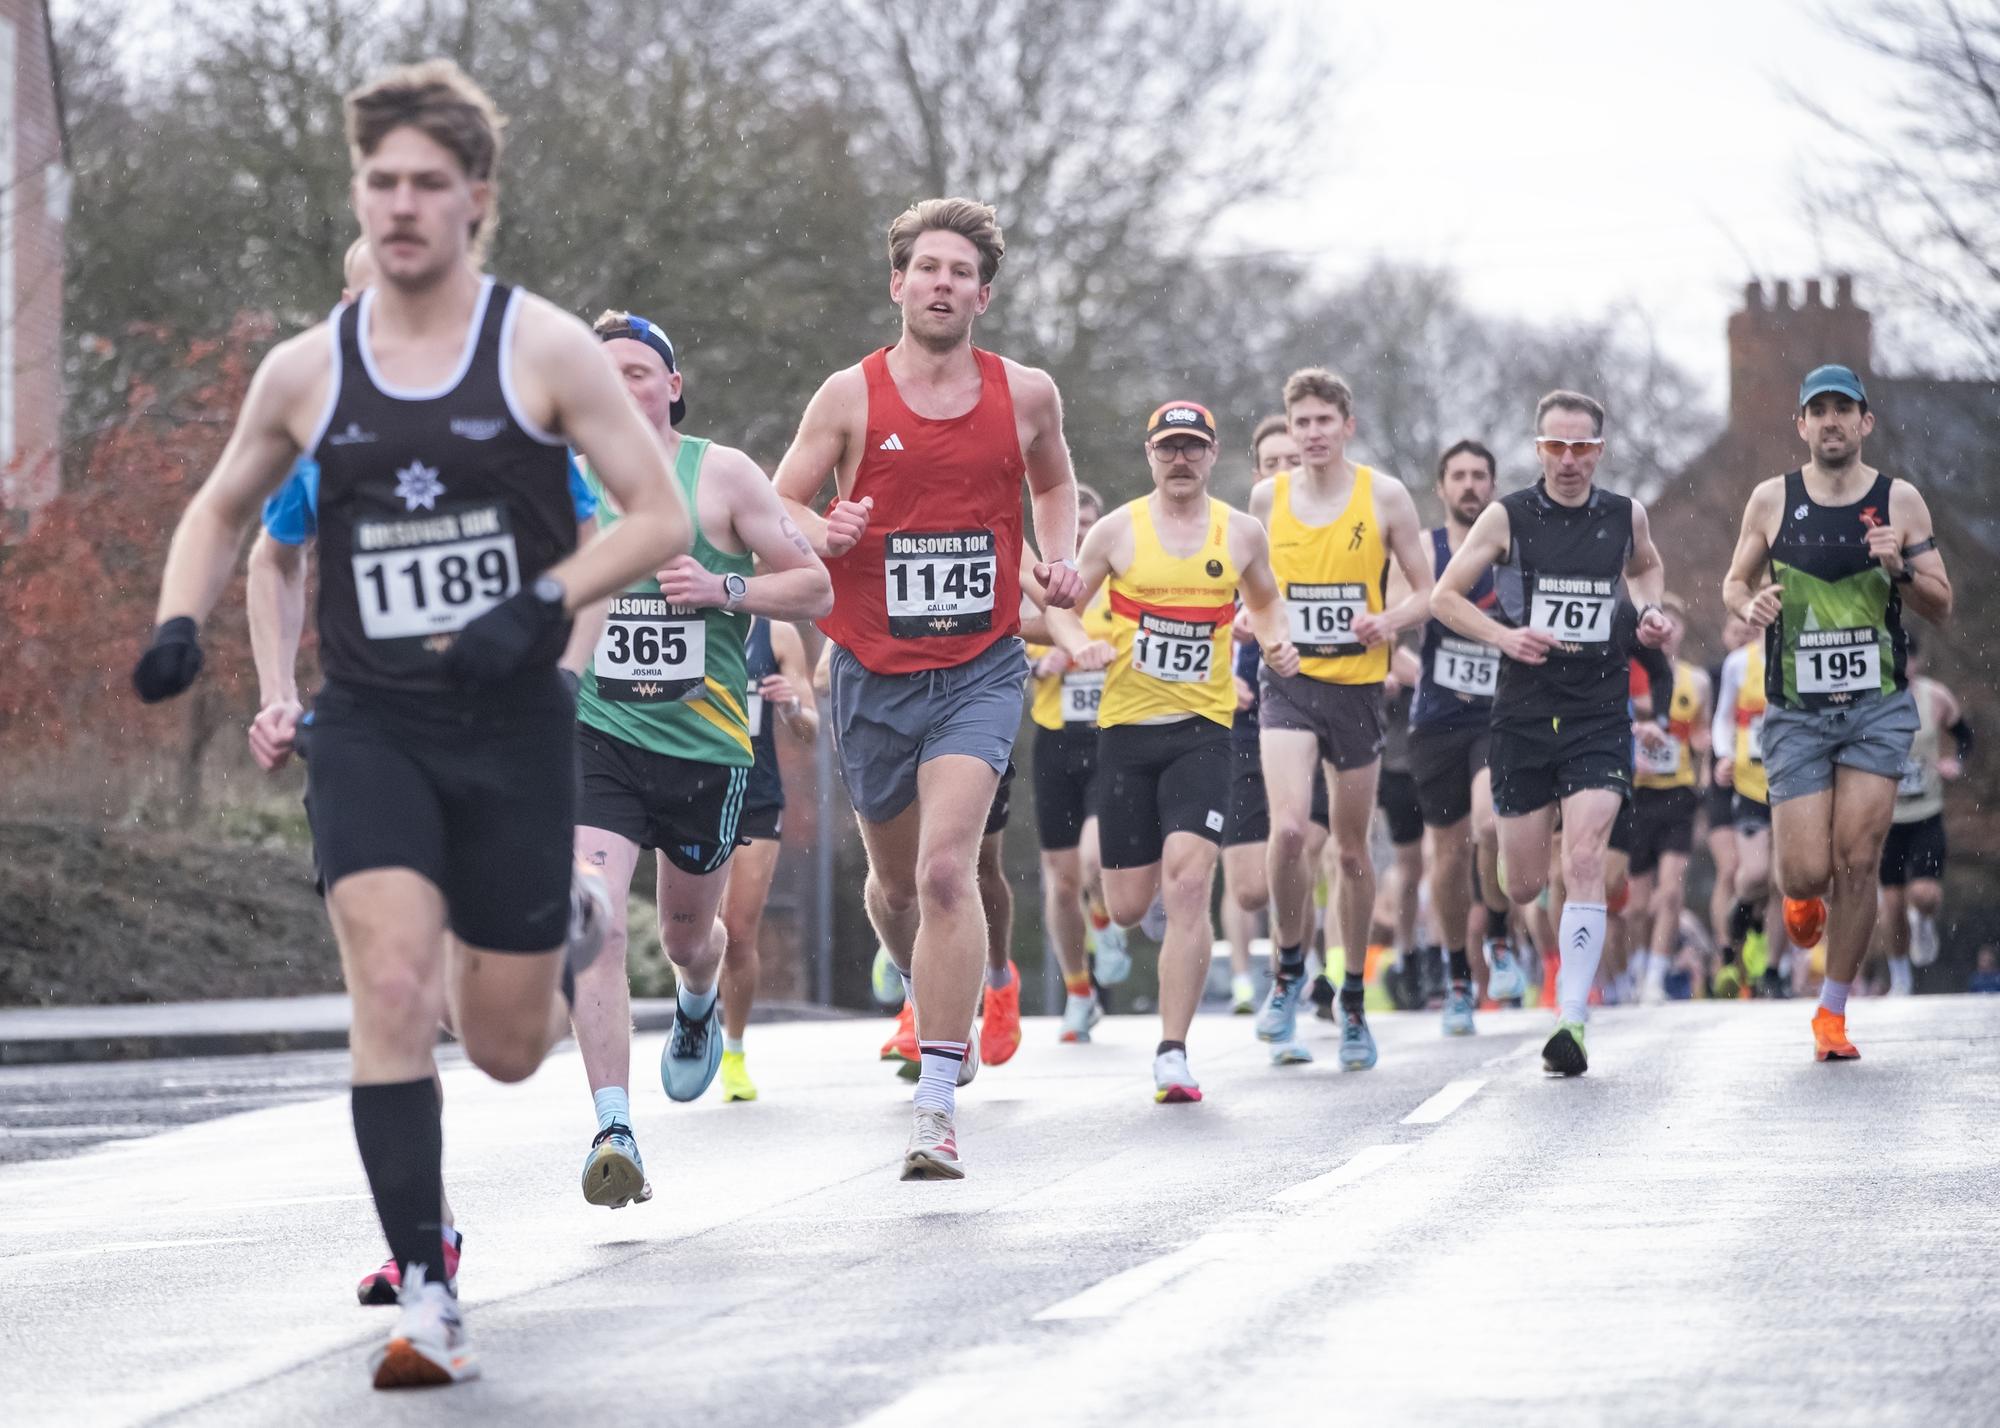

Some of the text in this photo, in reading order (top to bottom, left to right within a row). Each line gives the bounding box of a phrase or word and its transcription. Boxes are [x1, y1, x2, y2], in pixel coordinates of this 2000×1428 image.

[892, 535, 988, 554] BOLSOVER 10K
[365, 549, 510, 612] 1189
[889, 562, 992, 601] 1145
[1538, 578, 1611, 595] BOLSOVER 10K
[608, 598, 667, 616] OLSOVER
[927, 603, 958, 612] CALLUM
[1299, 605, 1354, 632] 169
[1545, 599, 1602, 630] 767
[1142, 614, 1195, 638] BOLSOVER
[1799, 627, 1873, 648] BOLSOVER 10K
[607, 625, 687, 665] 365
[1137, 637, 1211, 672] 1152
[631, 668, 662, 676] JOSHUA
[1447, 657, 1492, 686] 135
[1809, 650, 1867, 681] 195
[1073, 688, 1102, 711] 88
